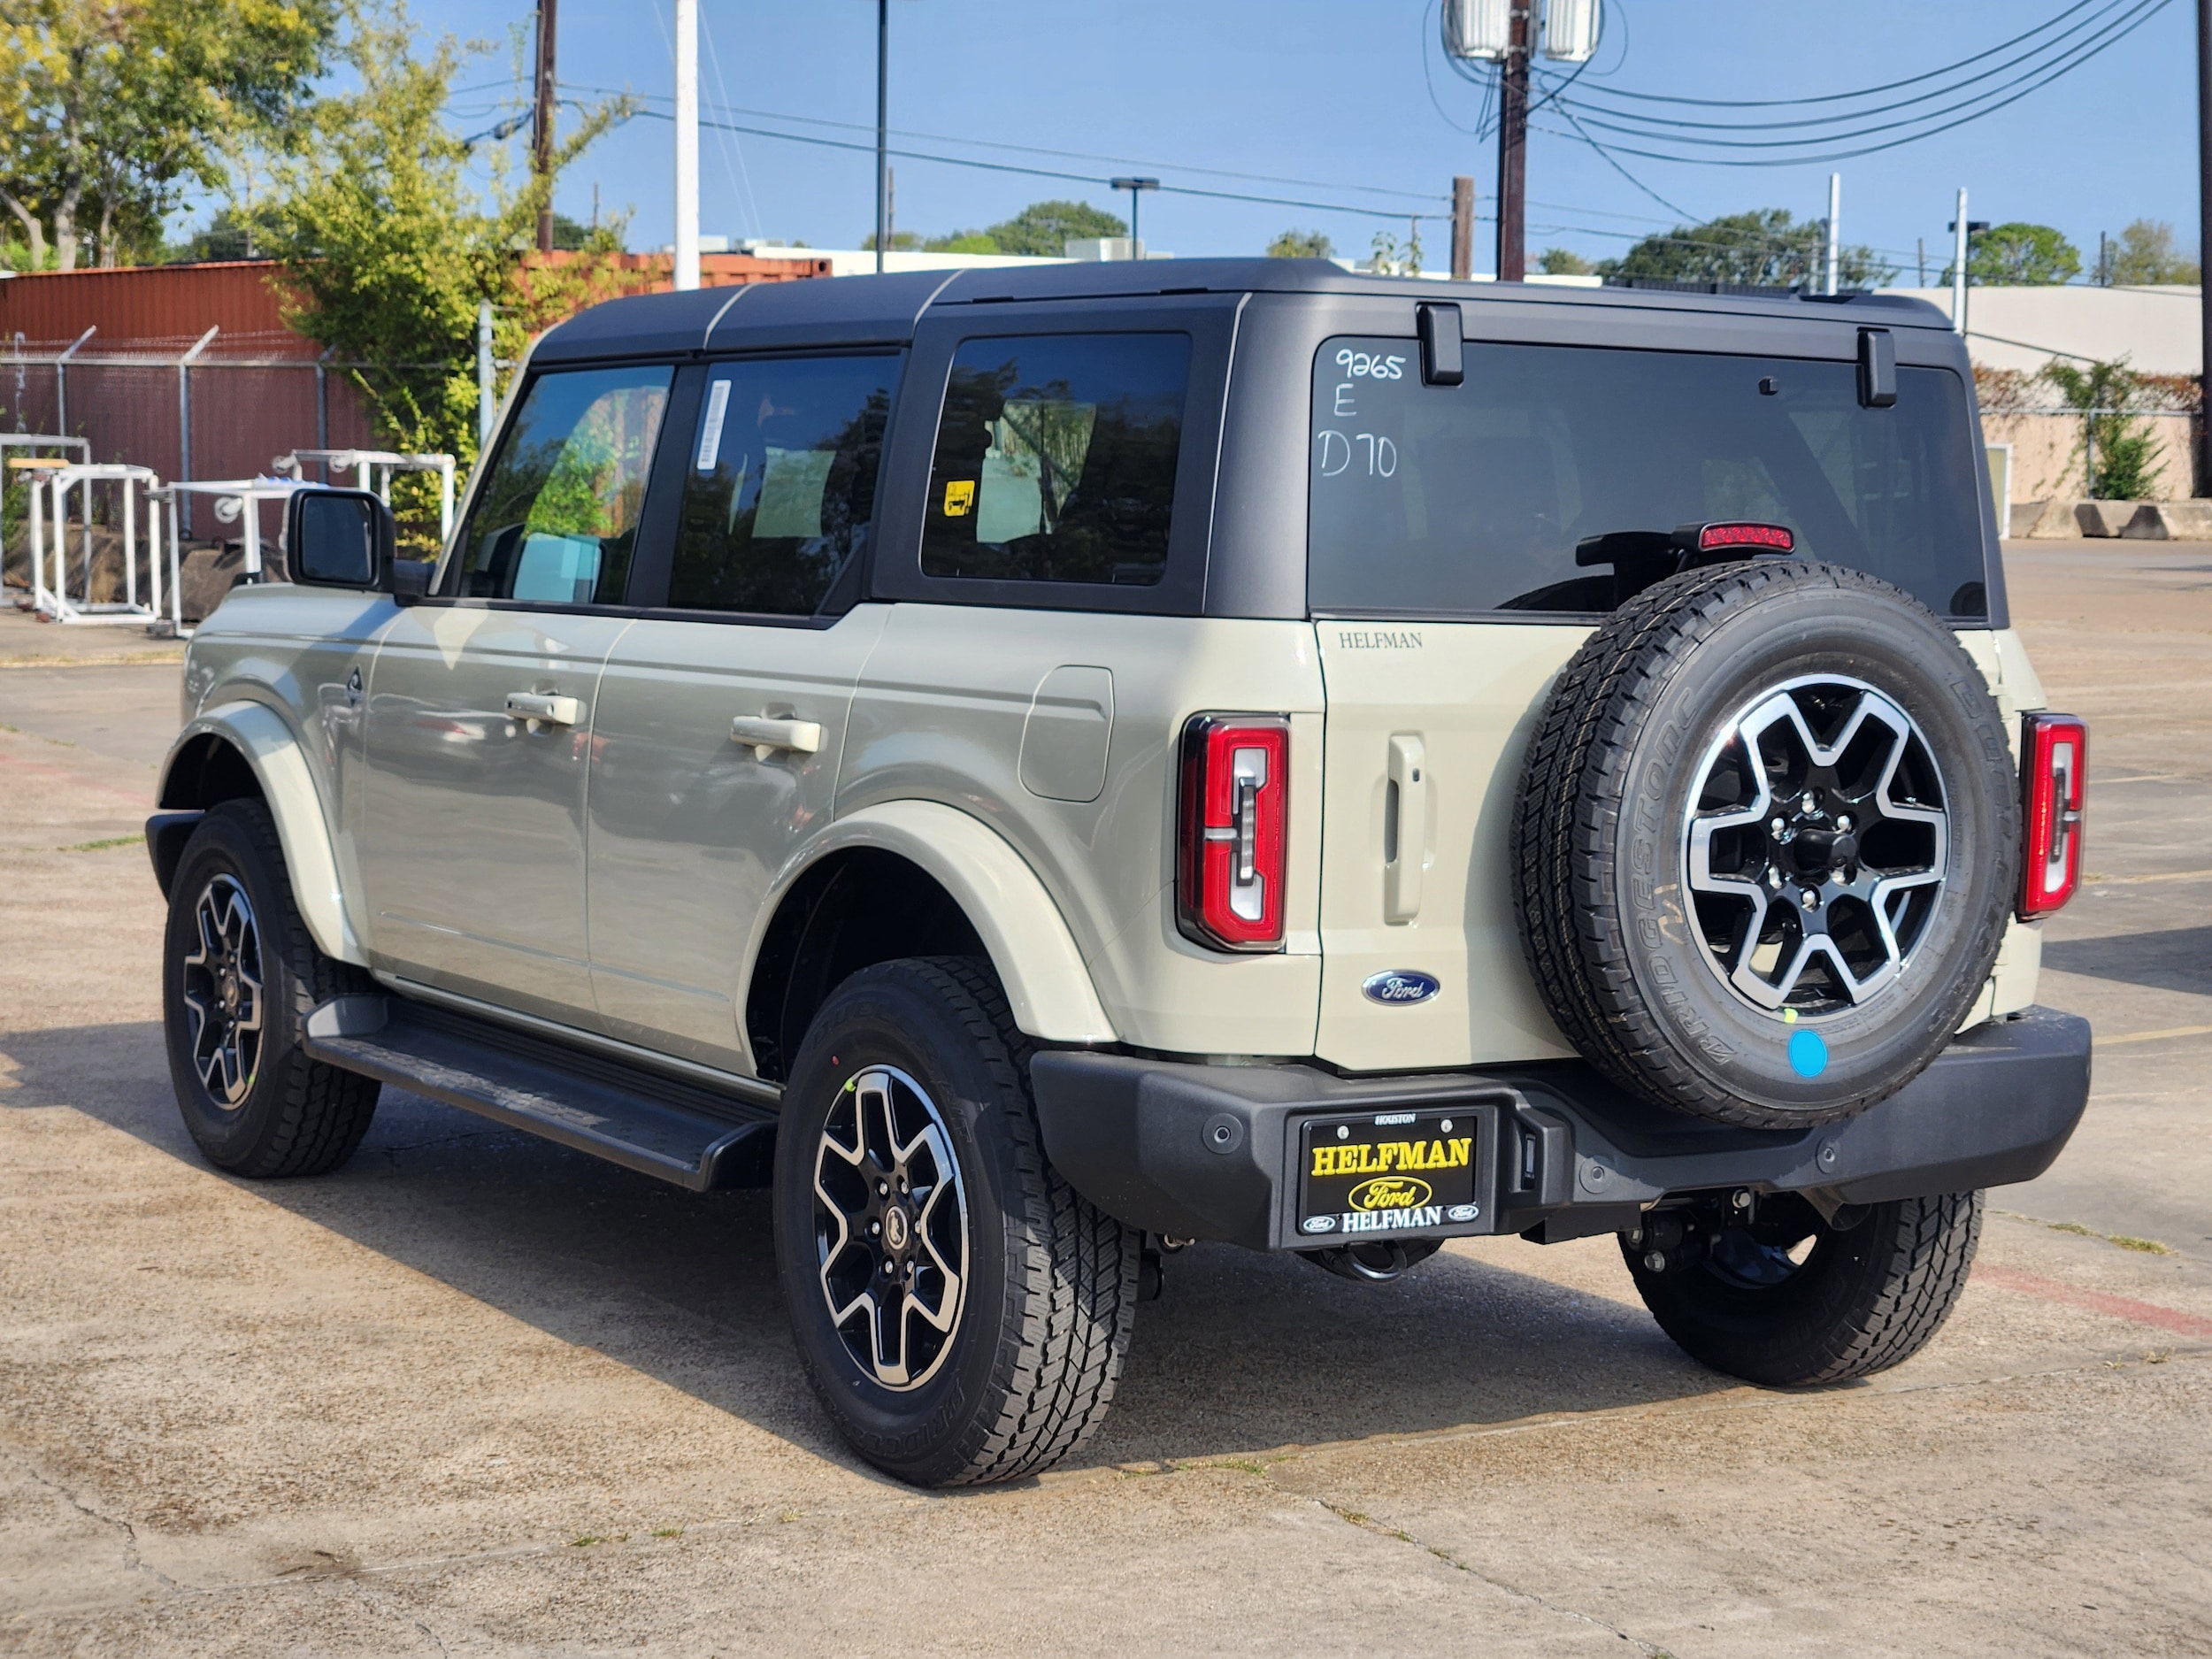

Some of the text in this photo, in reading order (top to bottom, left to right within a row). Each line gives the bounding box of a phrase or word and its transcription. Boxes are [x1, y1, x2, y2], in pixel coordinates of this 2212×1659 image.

[1336, 349, 1406, 380] 9265
[1334, 383, 1357, 416] E
[1339, 632, 1423, 649] HELFMAN
[1381, 977, 1425, 1000] Ford
[1374, 1113, 1416, 1126] HOUSTON
[1311, 1137, 1473, 1177] HELFMAN
[1363, 1181, 1417, 1209] Ford
[1341, 1205, 1444, 1233] HELFMAN
